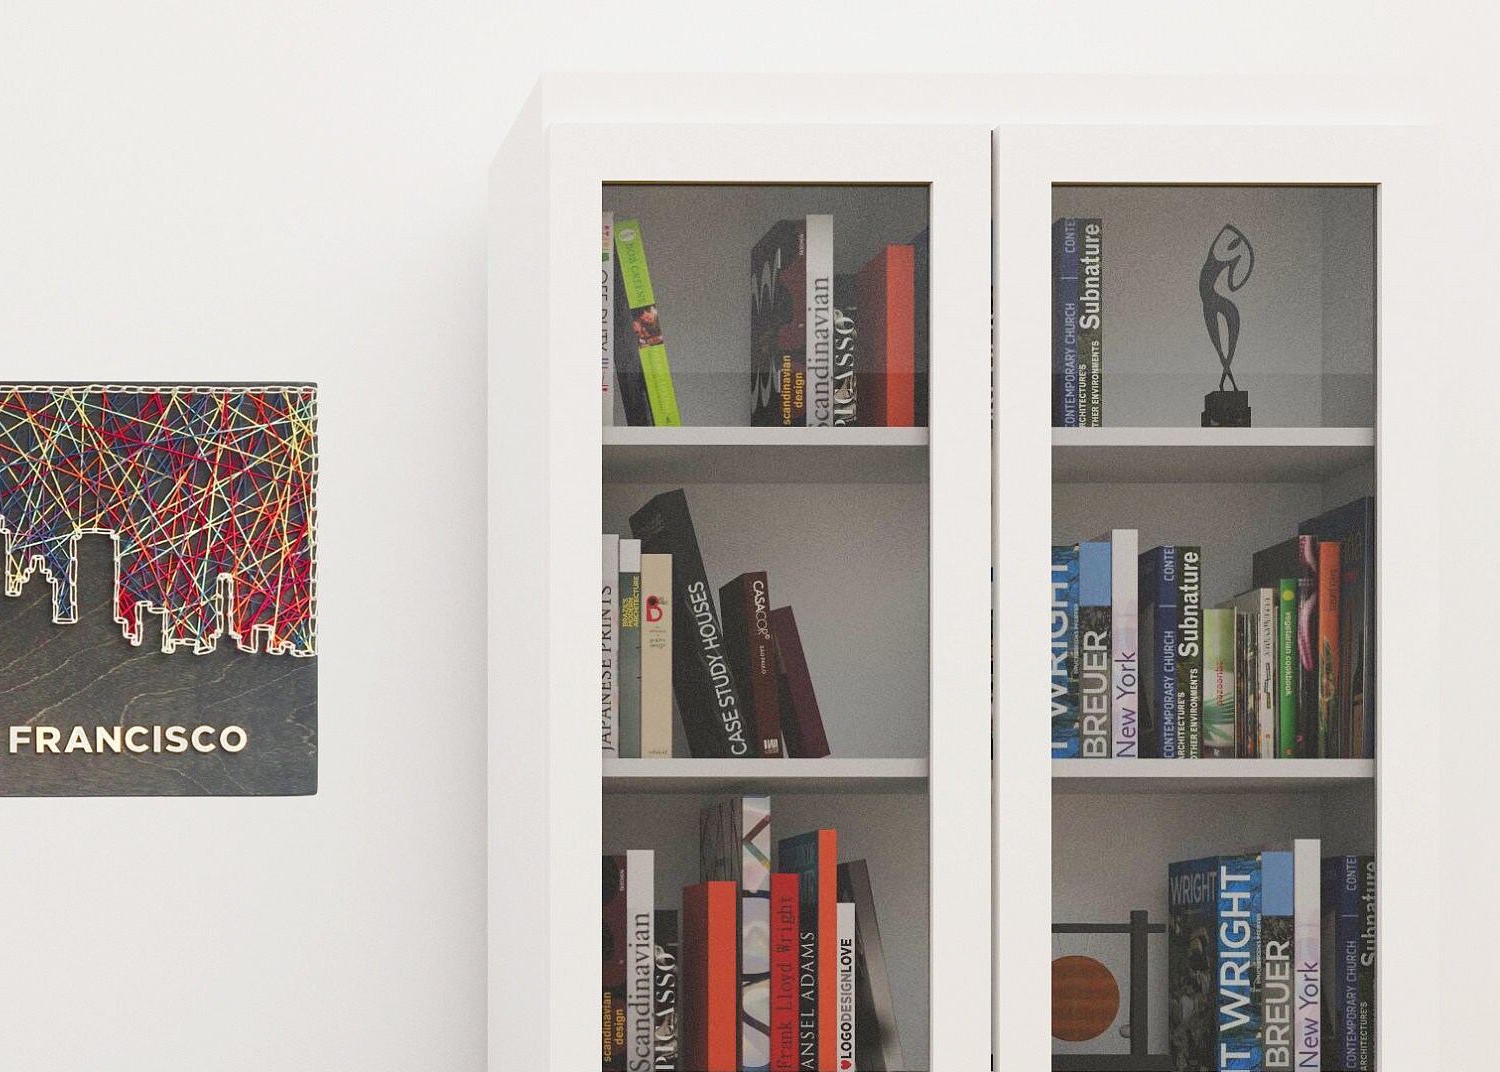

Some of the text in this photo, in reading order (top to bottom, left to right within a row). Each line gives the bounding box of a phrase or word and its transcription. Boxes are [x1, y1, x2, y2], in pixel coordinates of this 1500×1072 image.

[1065, 303, 1076, 344] CHURCH
[1079, 224, 1100, 330] Subnature
[782, 355, 791, 425] scandinavian
[795, 372, 805, 409] design
[1079, 364, 1087, 427] RCHITECTURE'S
[1164, 545, 1174, 582] CONTE
[1178, 551, 1198, 657] Subnature
[688, 582, 747, 755] CASE STUDY HOUSES
[1083, 631, 1108, 758] BREUER
[1114, 651, 1136, 758] New York
[1164, 631, 1174, 758] CONTEMPORARY CHURCH
[1190, 668, 1198, 732] ENVIRONMENTS
[1284, 611, 1293, 696] vegetarian cookbook
[9, 725, 248, 754] FRANCISCO
[1171, 872, 1217, 904] WRIGHT
[1346, 855, 1357, 892] CONTE
[1360, 862, 1375, 967] Subnature
[629, 913, 650, 1072] Scandinavian
[777, 895, 796, 1069] Frank Lloyd Wright
[801, 932, 815, 1069] ANSEL ADAMS
[1220, 866, 1250, 1031] WRIGHT
[603, 992, 612, 1063] scandinavian
[616, 1008, 624, 1046] design
[655, 953, 676, 1070] PICASSO
[1266, 941, 1289, 1068] BREUER
[1296, 961, 1318, 1069] New York
[1346, 941, 1357, 1068] CONTEMPORARY CHURCH
